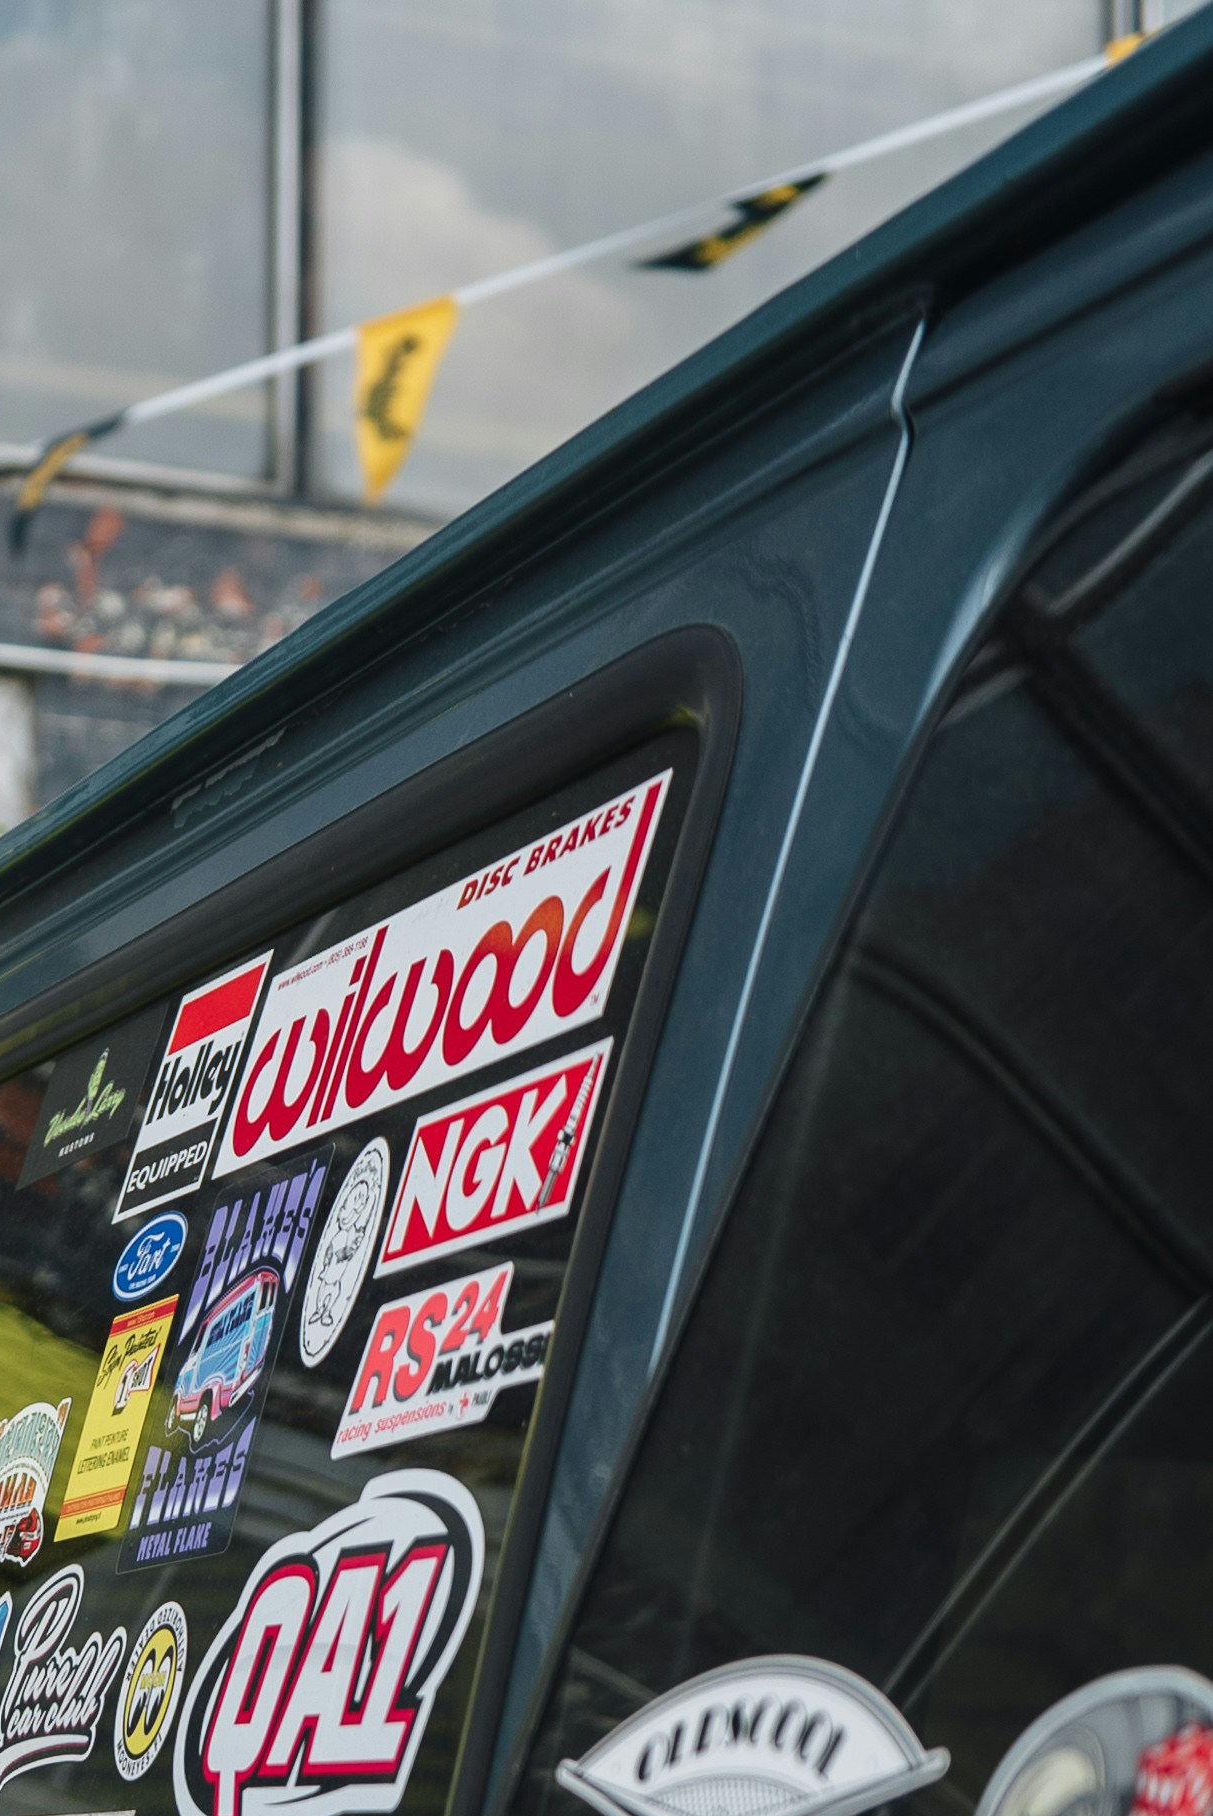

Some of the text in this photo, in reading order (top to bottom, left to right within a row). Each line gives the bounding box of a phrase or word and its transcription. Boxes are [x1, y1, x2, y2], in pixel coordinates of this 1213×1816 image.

[456, 795, 634, 911] DISC BRAKES
[232, 780, 663, 1158] wilwood
[145, 1038, 243, 1126] Holley
[126, 1140, 208, 1194] EQUIPPED
[389, 1073, 569, 1256] NGK
[337, 1419, 372, 1444] racing
[373, 1399, 448, 1435] suspensions
[76, 1453, 107, 1476] LETTERING
[129, 1416, 257, 1531] FLAKES
[136, 1521, 213, 1562] METAL FLAKE
[6, 1703, 46, 1740] car
